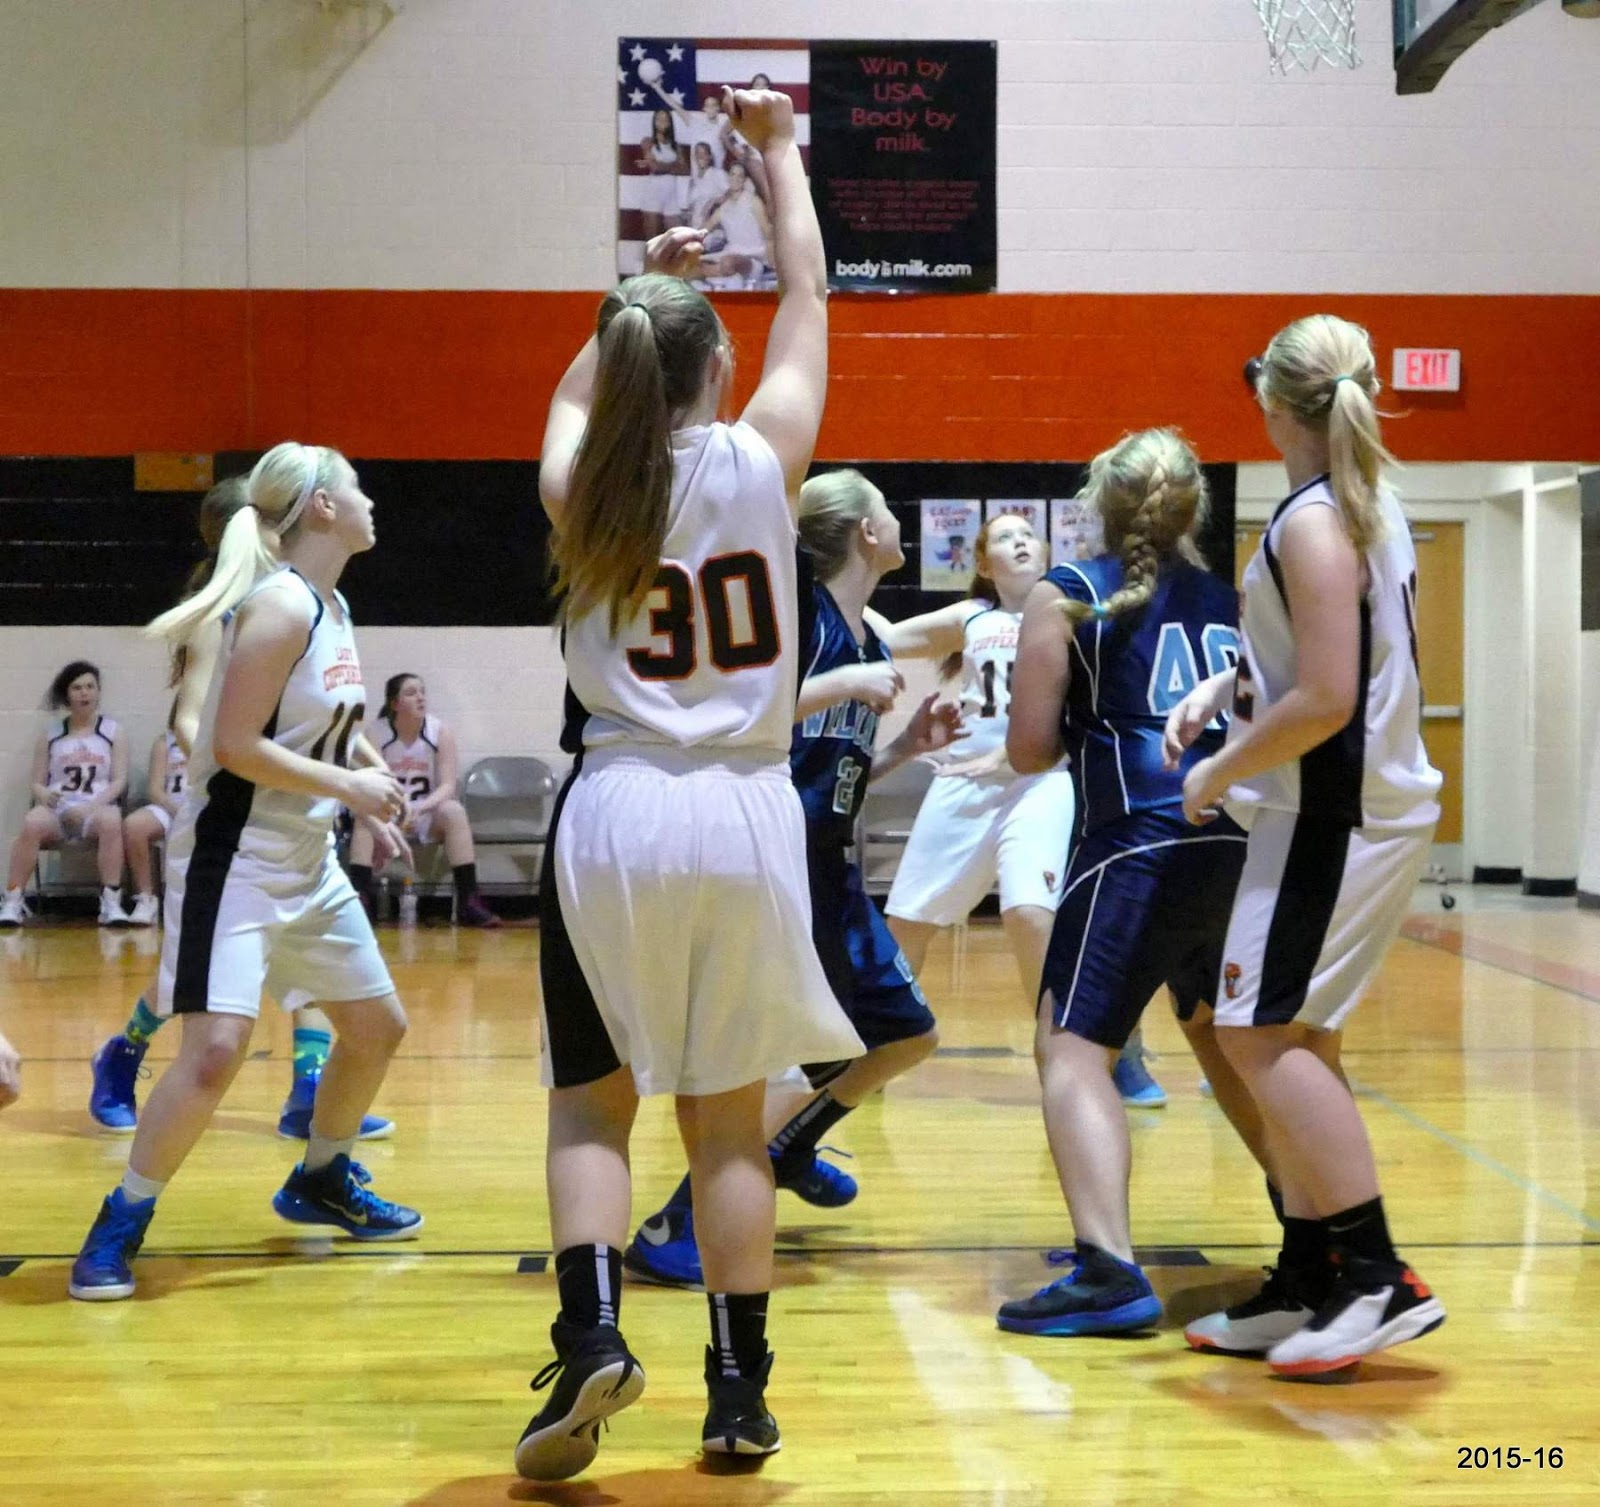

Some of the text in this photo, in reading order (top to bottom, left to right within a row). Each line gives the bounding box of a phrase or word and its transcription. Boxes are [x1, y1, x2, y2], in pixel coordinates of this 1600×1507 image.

[860, 57, 948, 80] Win by
[852, 107, 957, 130] Body by
[1406, 352, 1449, 385] EXIT
[626, 549, 782, 681] 30
[61, 766, 97, 793] 31
